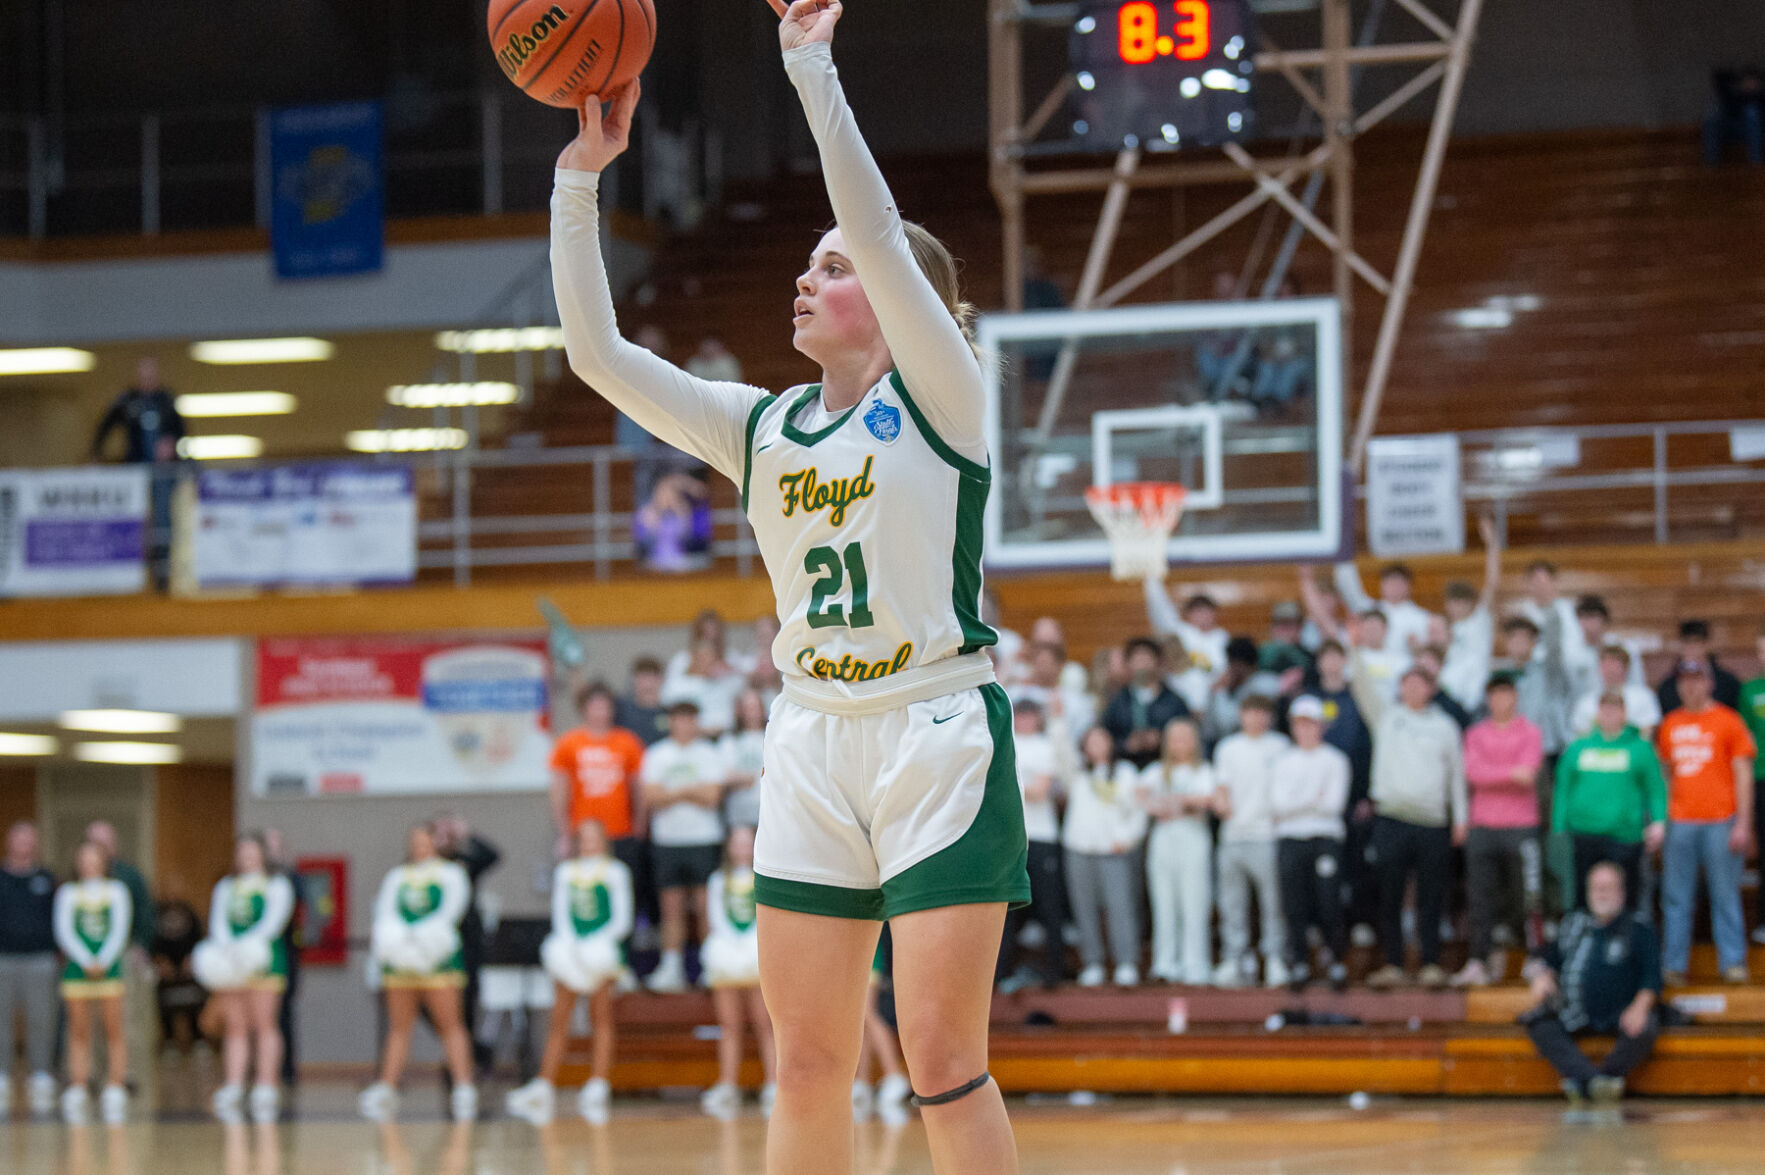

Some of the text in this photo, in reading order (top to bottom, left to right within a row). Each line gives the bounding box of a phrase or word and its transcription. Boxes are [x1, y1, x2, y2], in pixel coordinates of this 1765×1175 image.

[498, 4, 569, 81] Wilson
[1117, 0, 1210, 64] 8.3
[779, 454, 875, 527] Floyd
[804, 541, 874, 629] 21
[796, 641, 914, 683] Central
